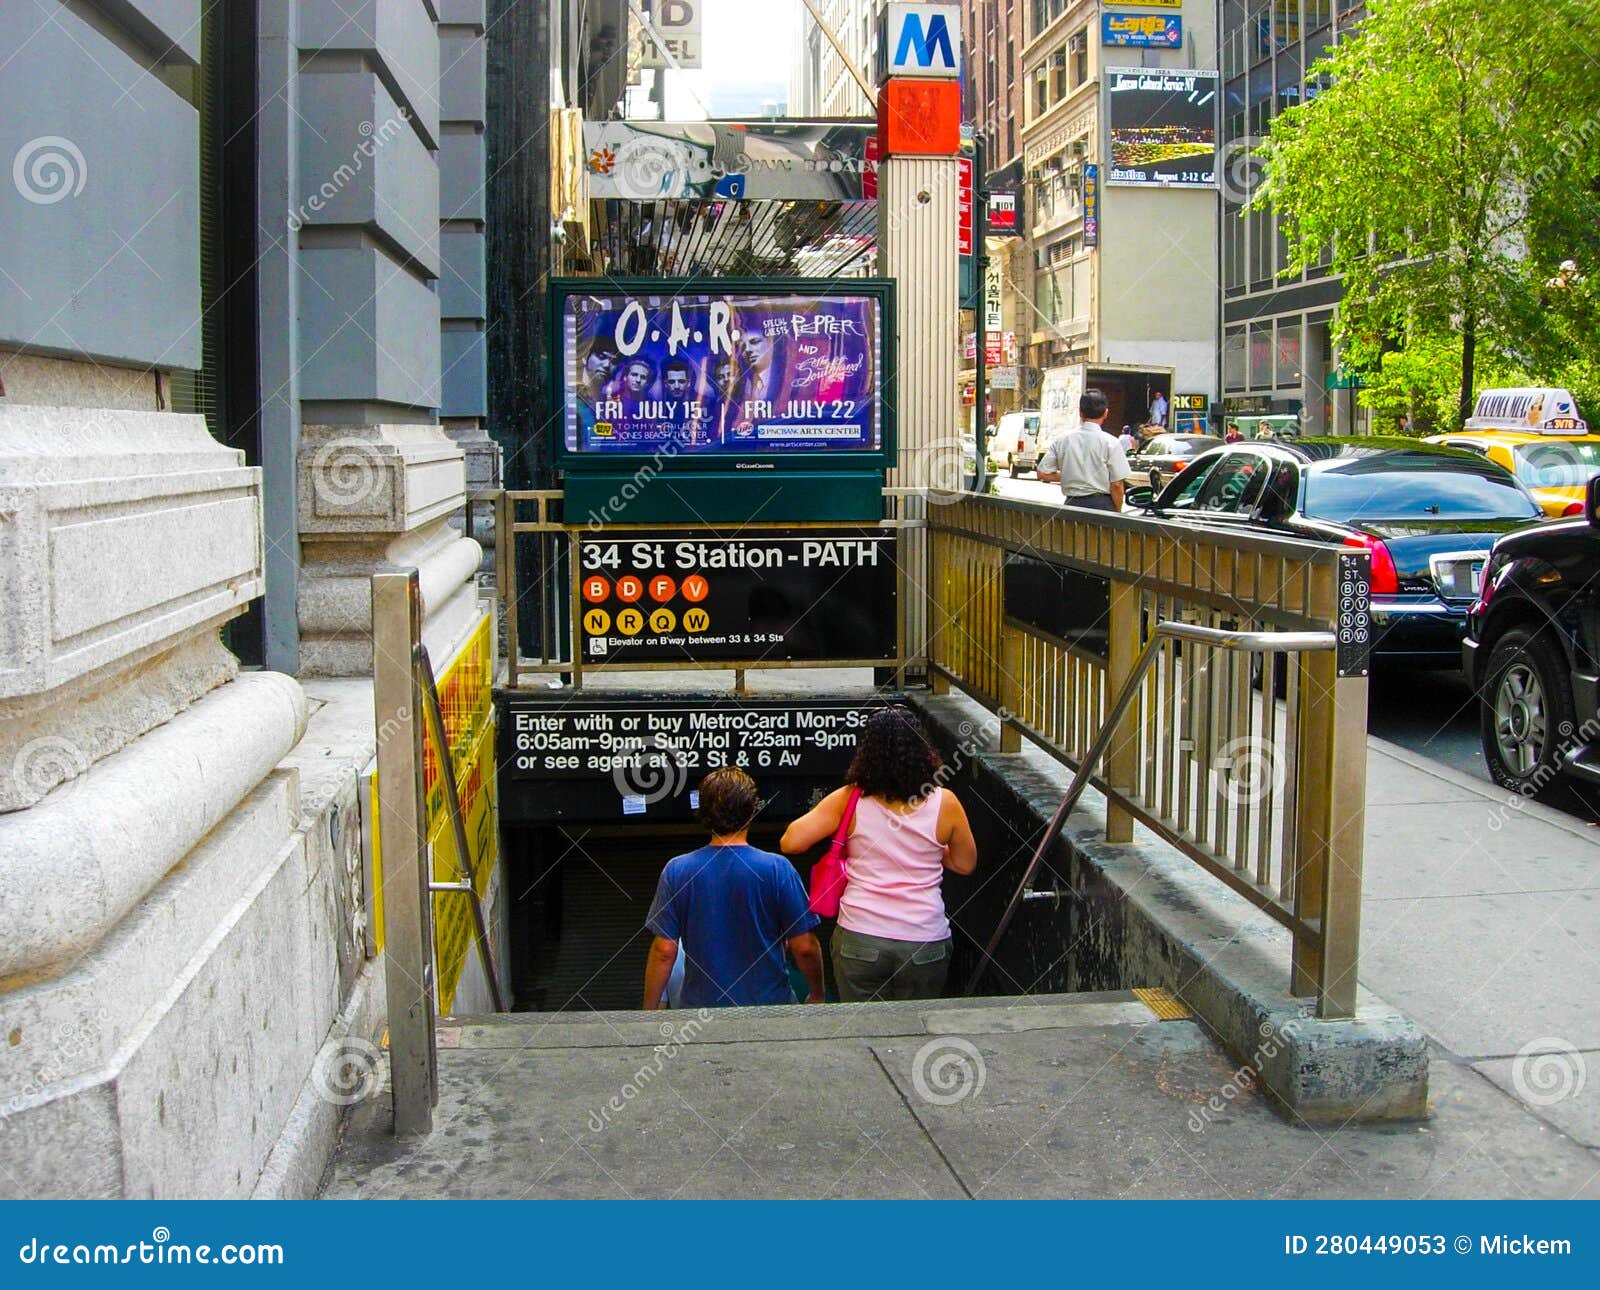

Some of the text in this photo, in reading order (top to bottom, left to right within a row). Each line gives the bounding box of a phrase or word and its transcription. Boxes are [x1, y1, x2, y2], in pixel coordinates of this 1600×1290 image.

[615, 300, 740, 357] O.A.R.
[798, 344, 819, 355] AND
[596, 401, 702, 420] FRI. JULY 15
[744, 400, 855, 419] FRI. JULY 22
[583, 543, 621, 569] 34
[632, 542, 665, 569] St
[1344, 558, 1357, 567] 34
[609, 633, 784, 648] Elevator on B'way between 33 & 34 Sts
[516, 714, 567, 731] Enter
[574, 714, 613, 731] with
[621, 717, 641, 731] or
[649, 713, 683, 734] buy
[690, 711, 789, 730] MetroCard
[517, 734, 647, 753] 6:05am-9pm,
[654, 733, 730, 750] Sun/Hol
[517, 751, 801, 772] or see agent at 32 St & 6 Av
